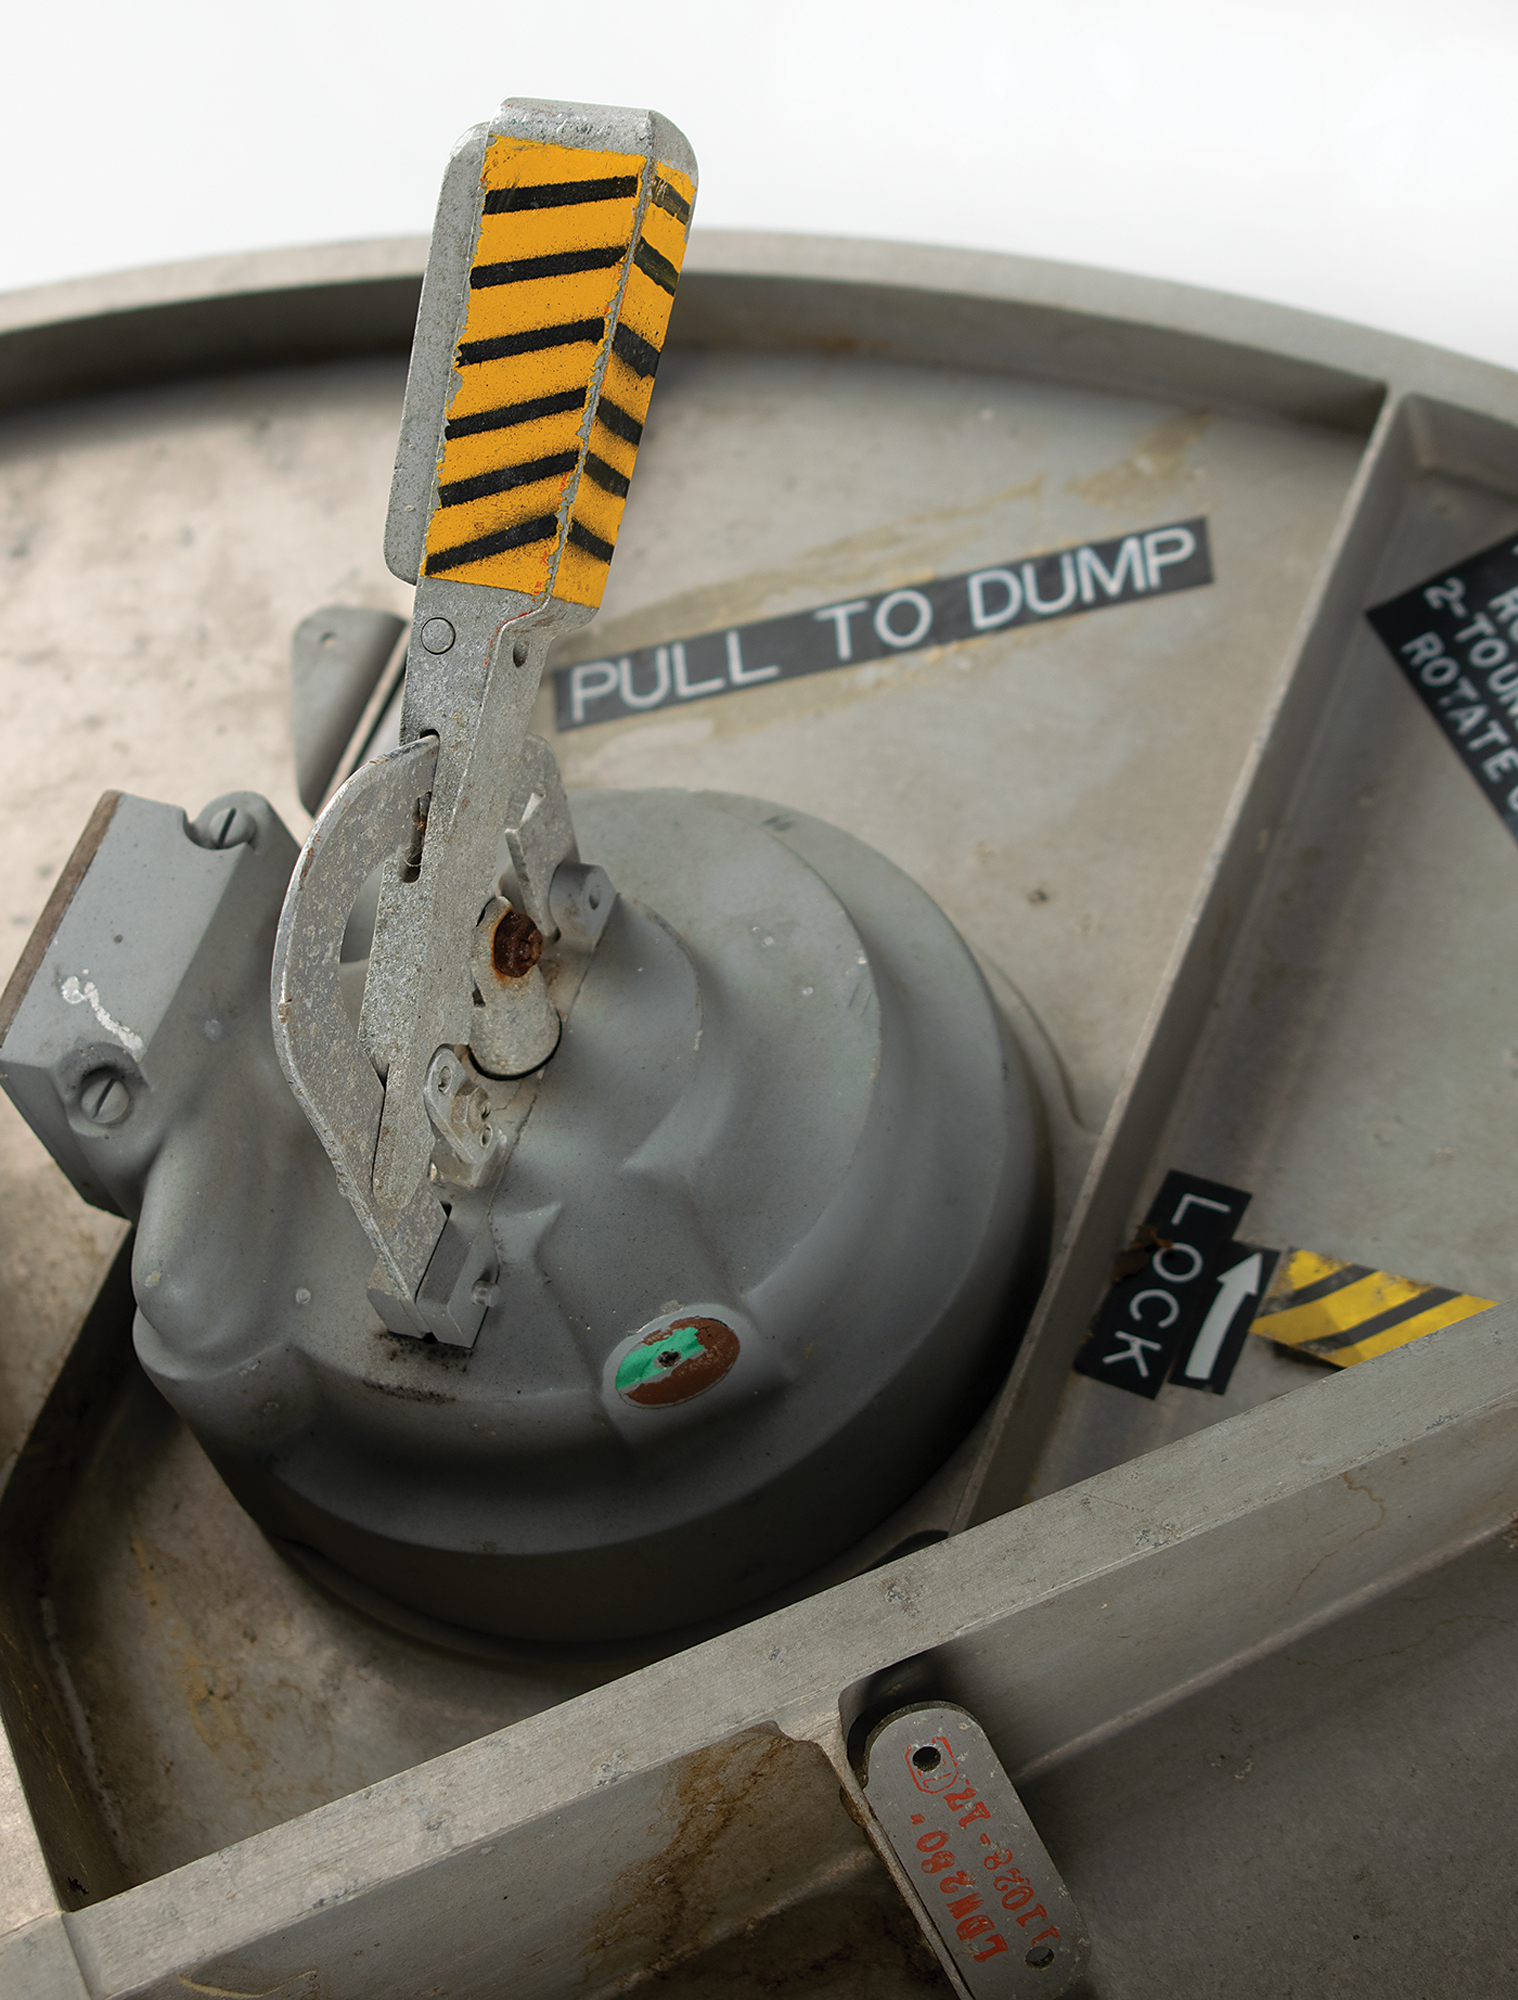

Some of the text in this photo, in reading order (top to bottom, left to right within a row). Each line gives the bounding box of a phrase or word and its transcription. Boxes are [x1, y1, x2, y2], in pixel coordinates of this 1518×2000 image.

[570, 526, 1197, 723] PULL TO DUMP
[1401, 631, 1518, 783] ROTATE
[1102, 1193, 1232, 1379] LOCK
